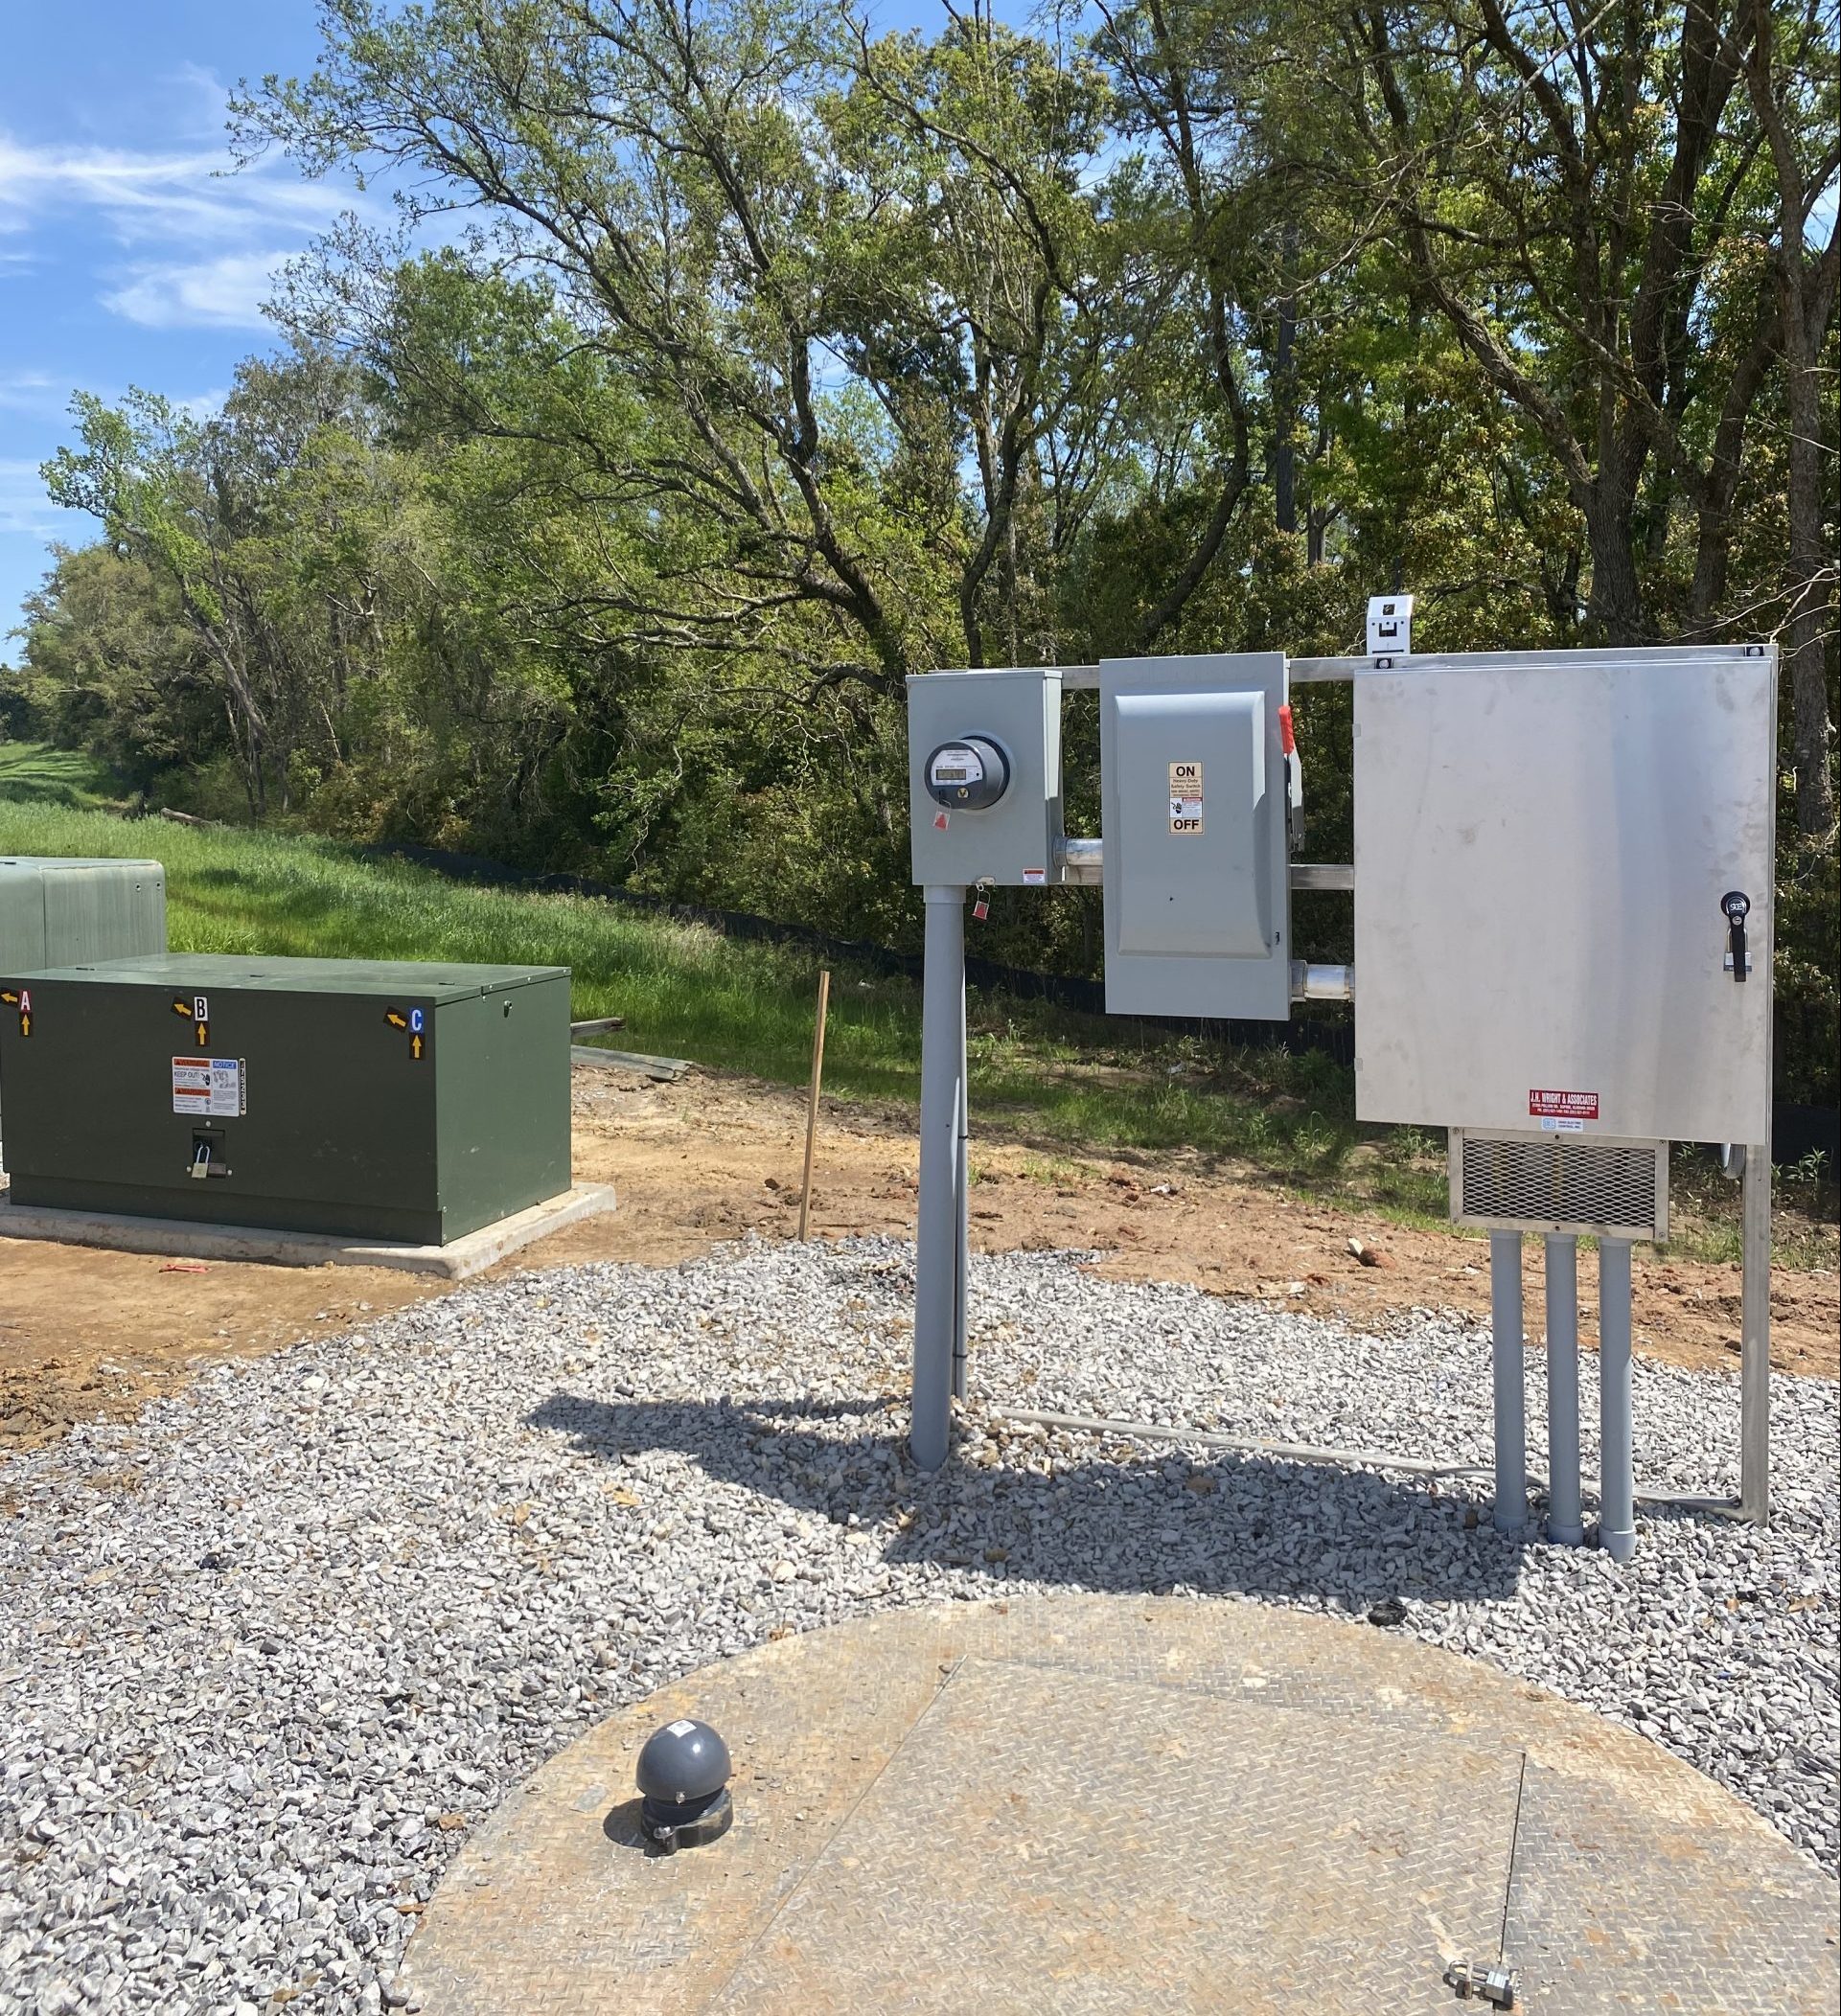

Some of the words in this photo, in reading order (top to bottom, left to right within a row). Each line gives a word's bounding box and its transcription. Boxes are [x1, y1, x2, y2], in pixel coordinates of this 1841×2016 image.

[1176, 766, 1195, 776] ON
[1173, 819, 1199, 830] OFF
[21, 991, 30, 1010] A
[196, 998, 206, 1018] B
[412, 1009, 422, 1031] C
[1542, 1091, 1561, 1104] WRIGHT
[1561, 1093, 1567, 1104] &
[1567, 1093, 1598, 1106] ASSOCIATES
